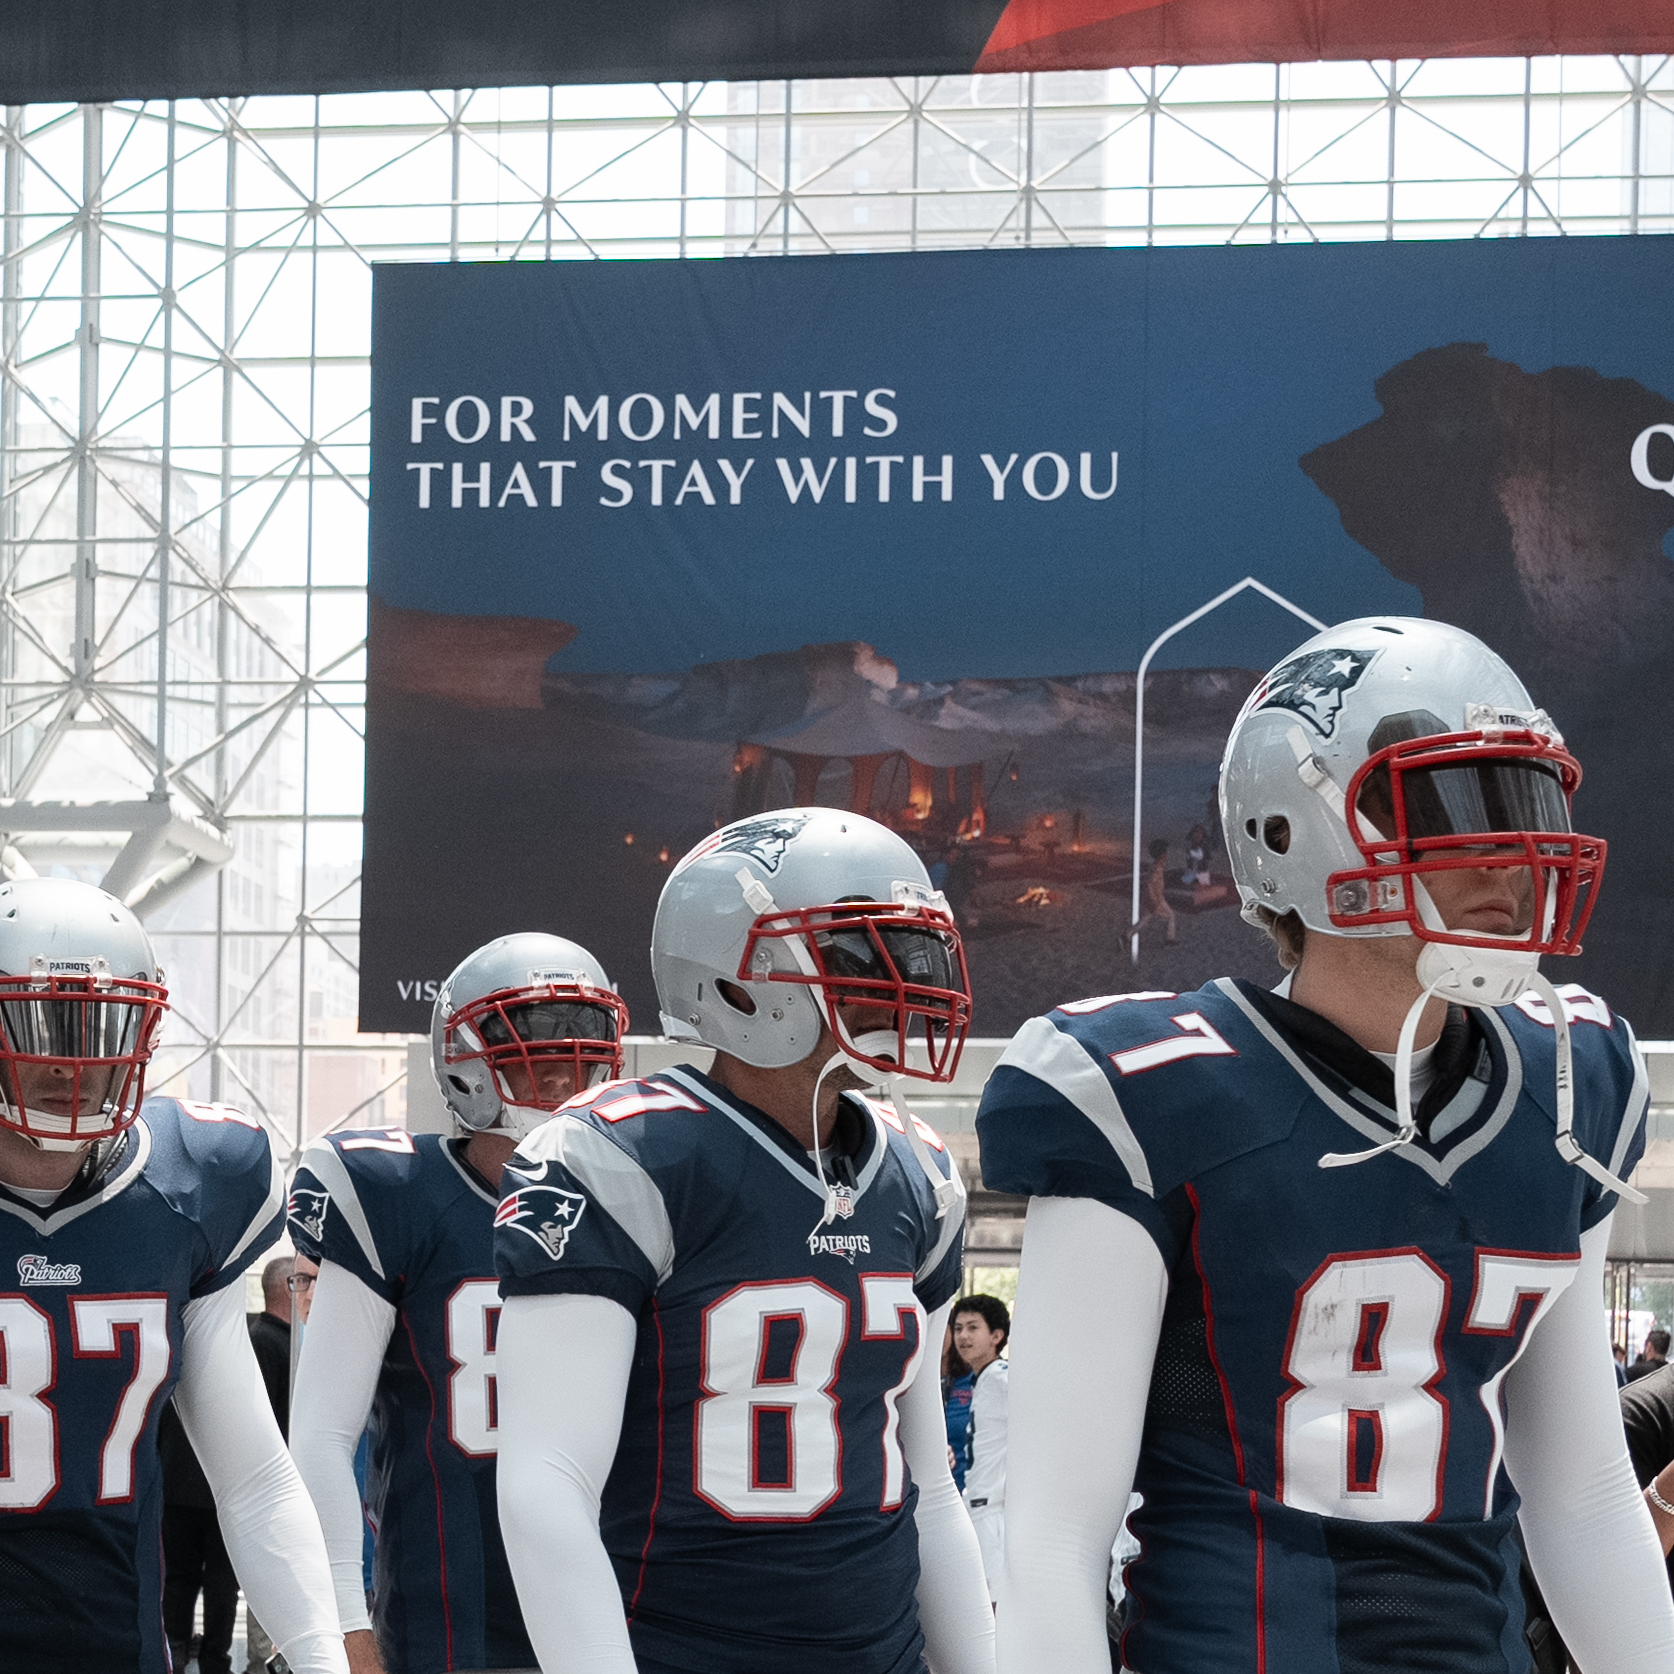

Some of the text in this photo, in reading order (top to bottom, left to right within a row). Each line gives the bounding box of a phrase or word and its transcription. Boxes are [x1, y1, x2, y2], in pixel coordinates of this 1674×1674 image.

[410, 388, 899, 443] FOR MOMENTS
[406, 451, 1119, 509] THAT STAY WITH YOU
[49, 962, 91, 973] PATRIOTS
[809, 1234, 871, 1256] PATRIOTS
[21, 1264, 78, 1284] Patriots
[694, 1274, 927, 1523] 87
[1275, 1246, 1582, 1523] 87
